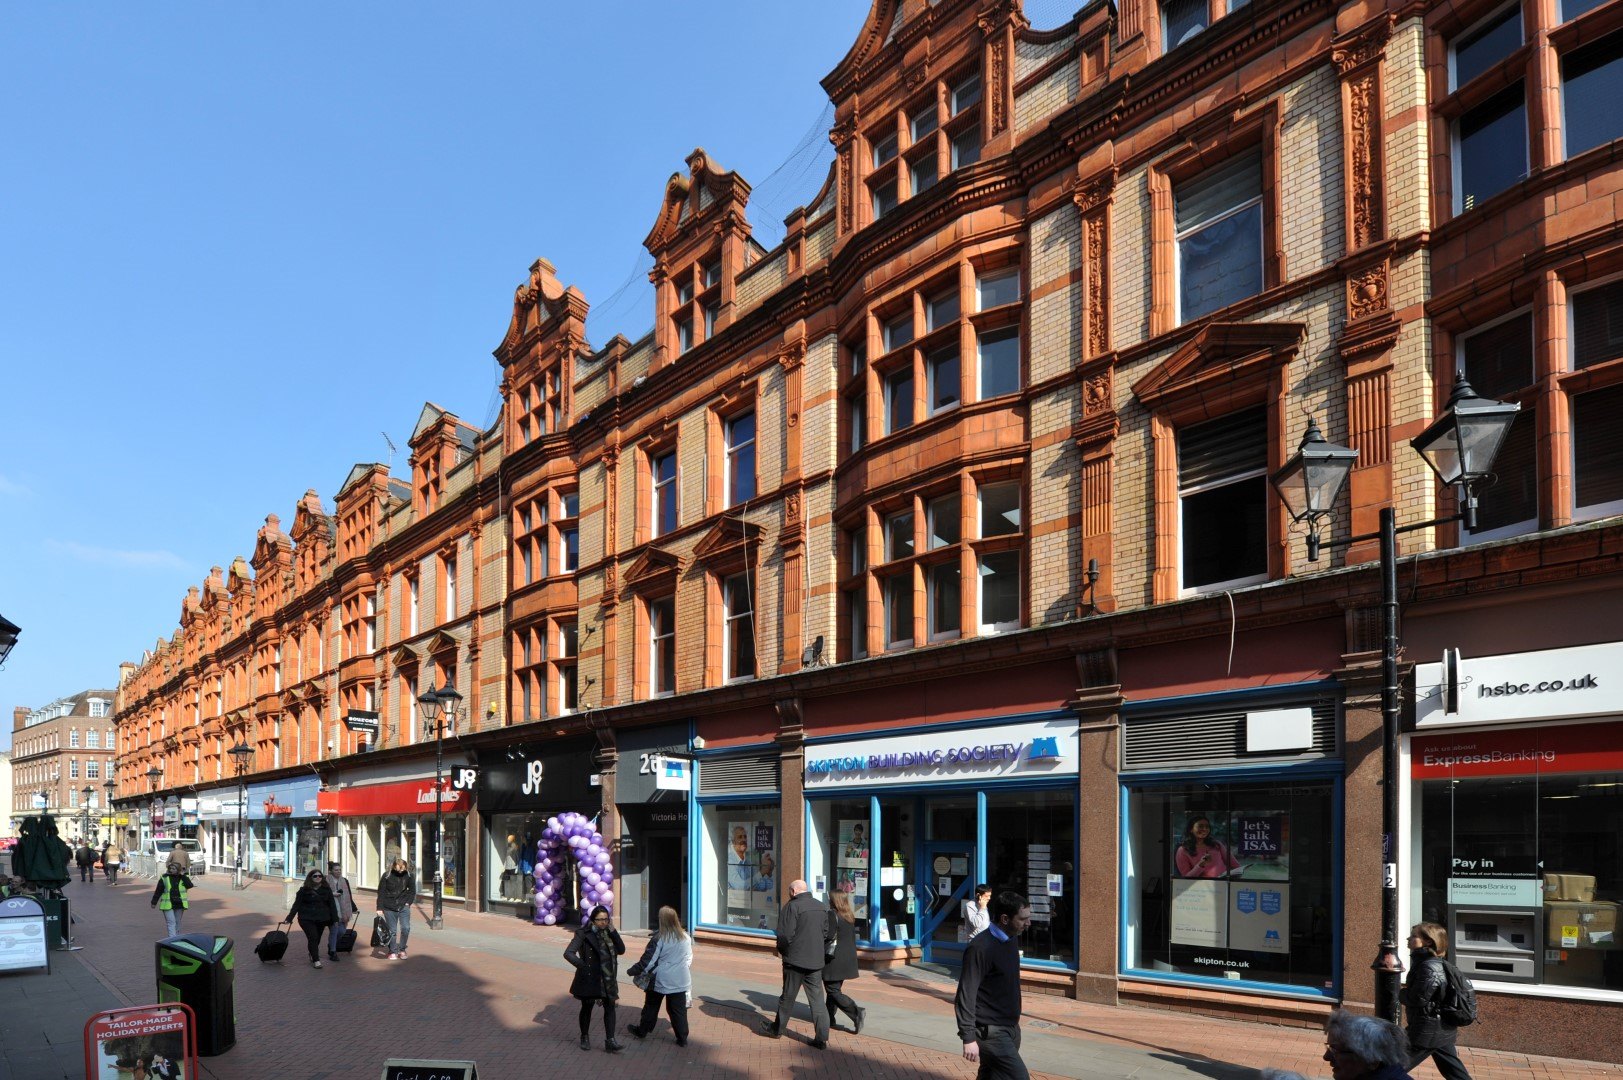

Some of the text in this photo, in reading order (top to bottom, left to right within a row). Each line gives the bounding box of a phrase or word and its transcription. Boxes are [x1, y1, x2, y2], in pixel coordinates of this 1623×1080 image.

[1480, 674, 1598, 698] hsbc.co.uk
[1453, 743, 1477, 751] about
[807, 742, 1023, 774] SKIPTON BUILDING SOCIETY
[1424, 749, 1555, 767] ExpressBanking
[454, 768, 477, 789] JOY
[522, 760, 543, 795] JOY
[417, 786, 460, 803] Ladbokes
[651, 813, 676, 821] Victoria
[1244, 830, 1269, 840] talk
[1243, 840, 1277, 851] ISAs
[1452, 858, 1494, 869] Pay in
[7, 900, 28, 909] QV
[1193, 956, 1250, 968] skipton.co.uk
[108, 1015, 173, 1029] TAILOR-MADE
[97, 1022, 183, 1038] HOLIDAY EXPERTS
